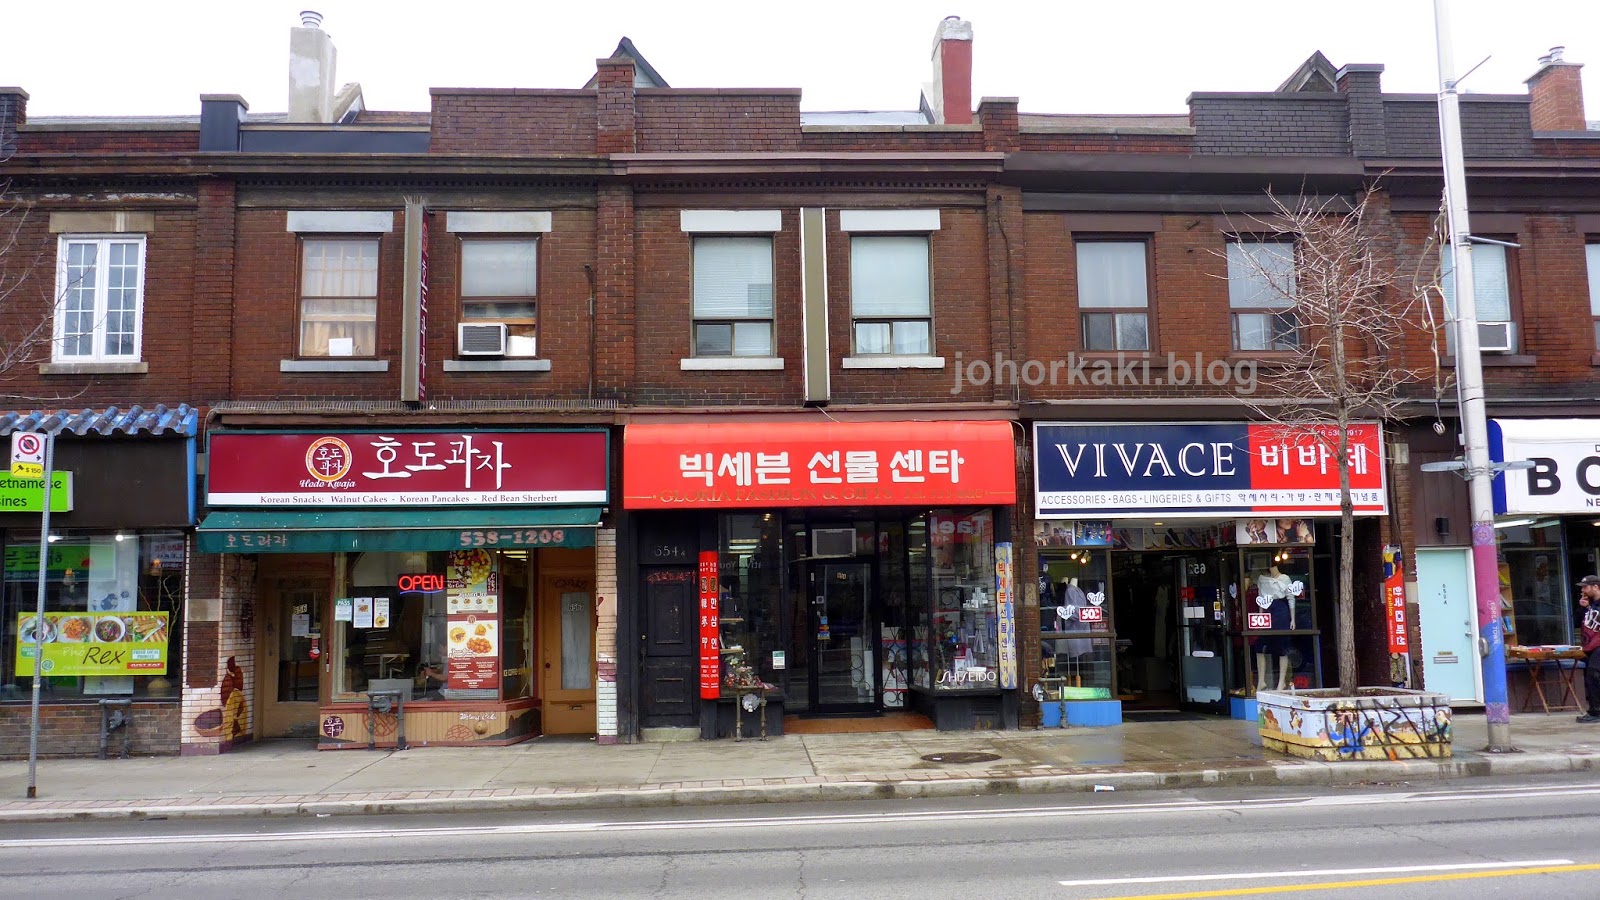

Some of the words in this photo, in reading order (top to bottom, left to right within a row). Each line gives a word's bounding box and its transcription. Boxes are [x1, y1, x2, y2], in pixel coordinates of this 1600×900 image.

[316, 446, 343, 460] 호도
[1055, 442, 1236, 477] VIVACE
[320, 460, 343, 476] 과자
[362, 435, 512, 489] 호도과자
[679, 452, 791, 487] 빅세븐
[807, 450, 879, 484] 선물
[890, 449, 965, 484] 센타
[327, 479, 356, 489] Kwaja
[260, 495, 290, 503] Korean
[293, 495, 324, 503] Snacks:
[331, 495, 361, 503] Walnut
[363, 495, 388, 503] Cakes
[400, 495, 429, 503] Korean
[432, 495, 470, 503] Pancakes
[482, 494, 498, 502] Red
[500, 494, 520, 502] Bean
[522, 494, 558, 502] Sherbert
[660, 489, 732, 502] GLORIA
[736, 488, 817, 501] FASHION
[823, 489, 838, 500] &
[1041, 494, 1106, 505] ACCESSORIES
[1113, 494, 1137, 504] BAGS
[1144, 493, 1192, 504] LINGERIES
[1195, 493, 1202, 503] &
[1205, 492, 1231, 503] GIFTS
[460, 530, 565, 546] 538-1208
[399, 575, 445, 591] OPEN
[83, 646, 126, 665] Rex
[937, 670, 996, 684] SHISEIDO
